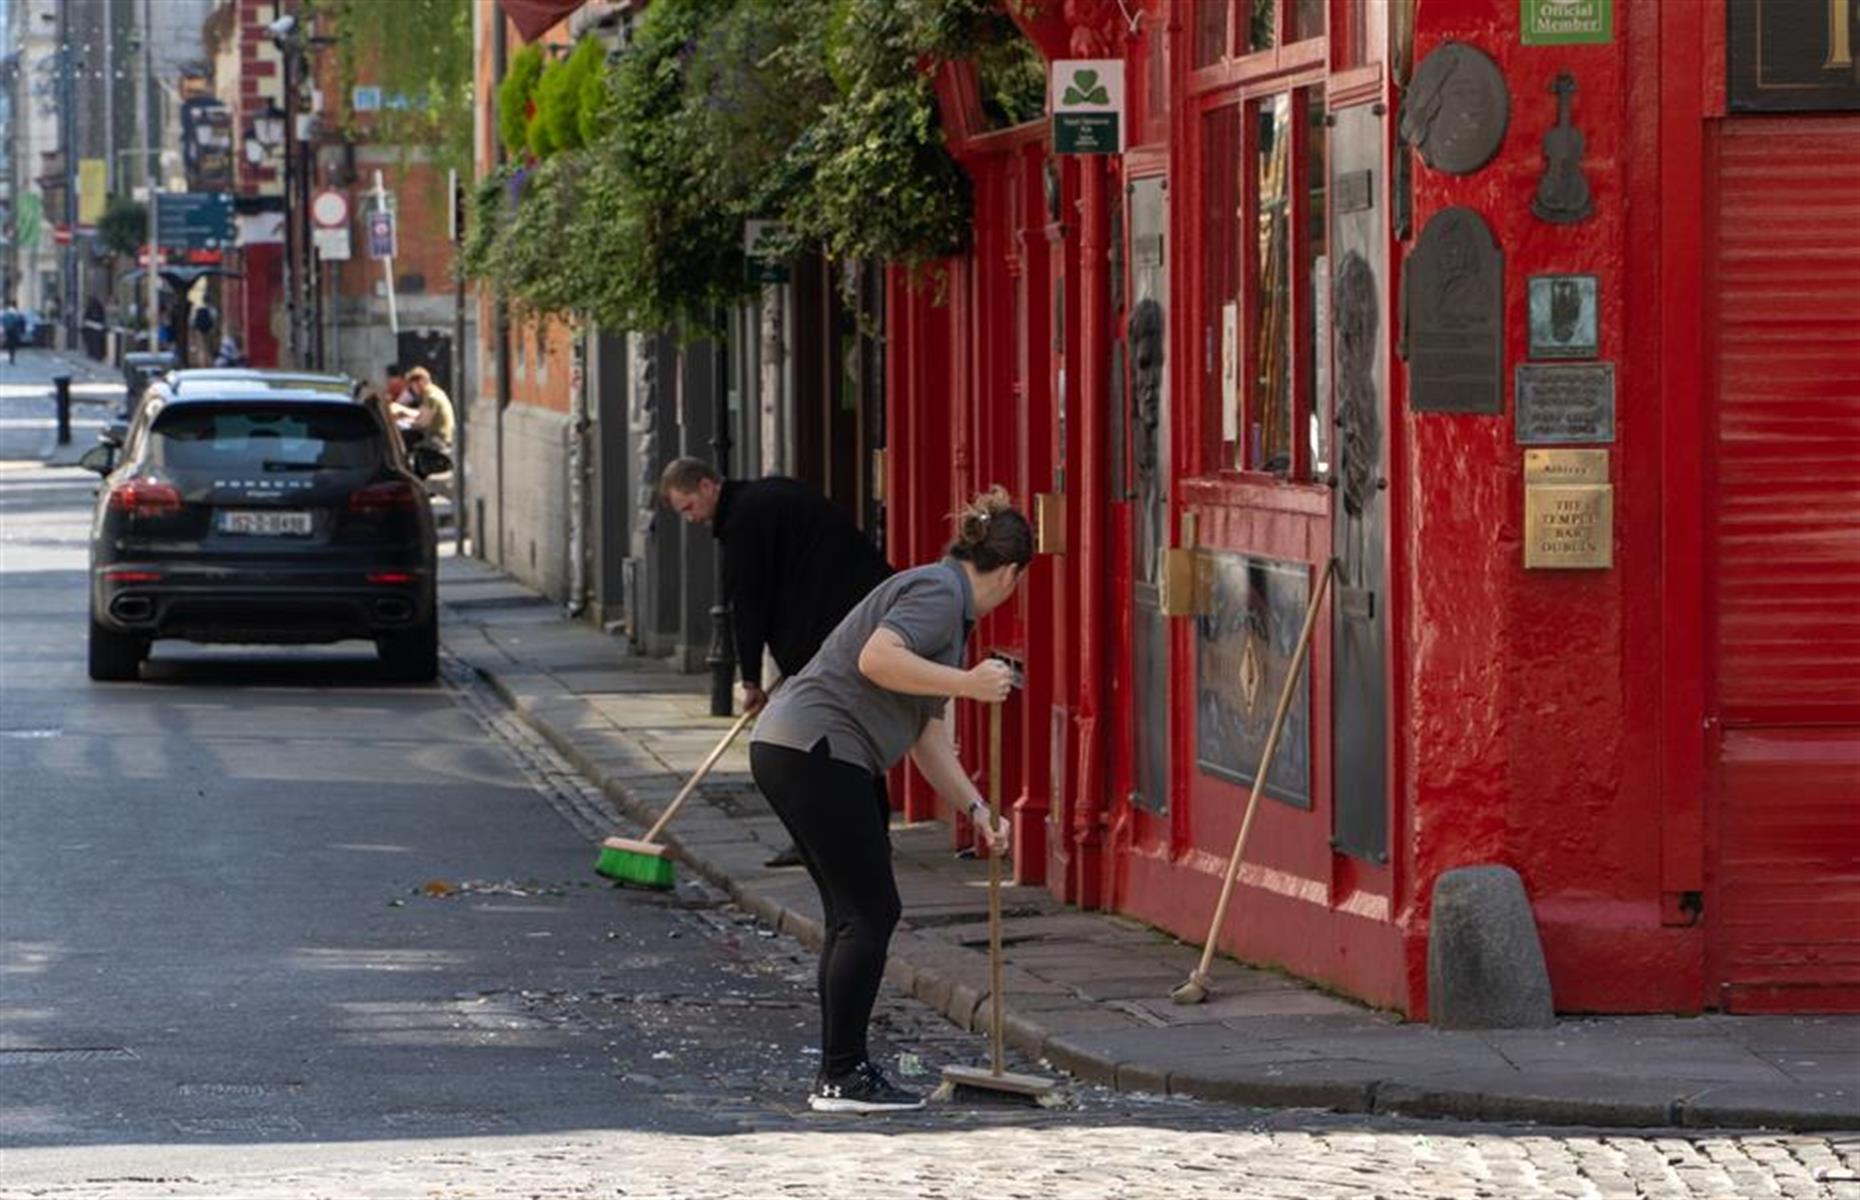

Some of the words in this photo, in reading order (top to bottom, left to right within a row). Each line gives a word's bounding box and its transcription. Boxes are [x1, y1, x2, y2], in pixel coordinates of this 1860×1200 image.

[1540, 3, 1593, 16] Official
[1537, 17, 1603, 32] Member
[1555, 500, 1582, 511] THE
[1542, 513, 1596, 524] TEMPLE
[1555, 528, 1583, 538] BAR
[1541, 541, 1597, 553] DUBLIN
